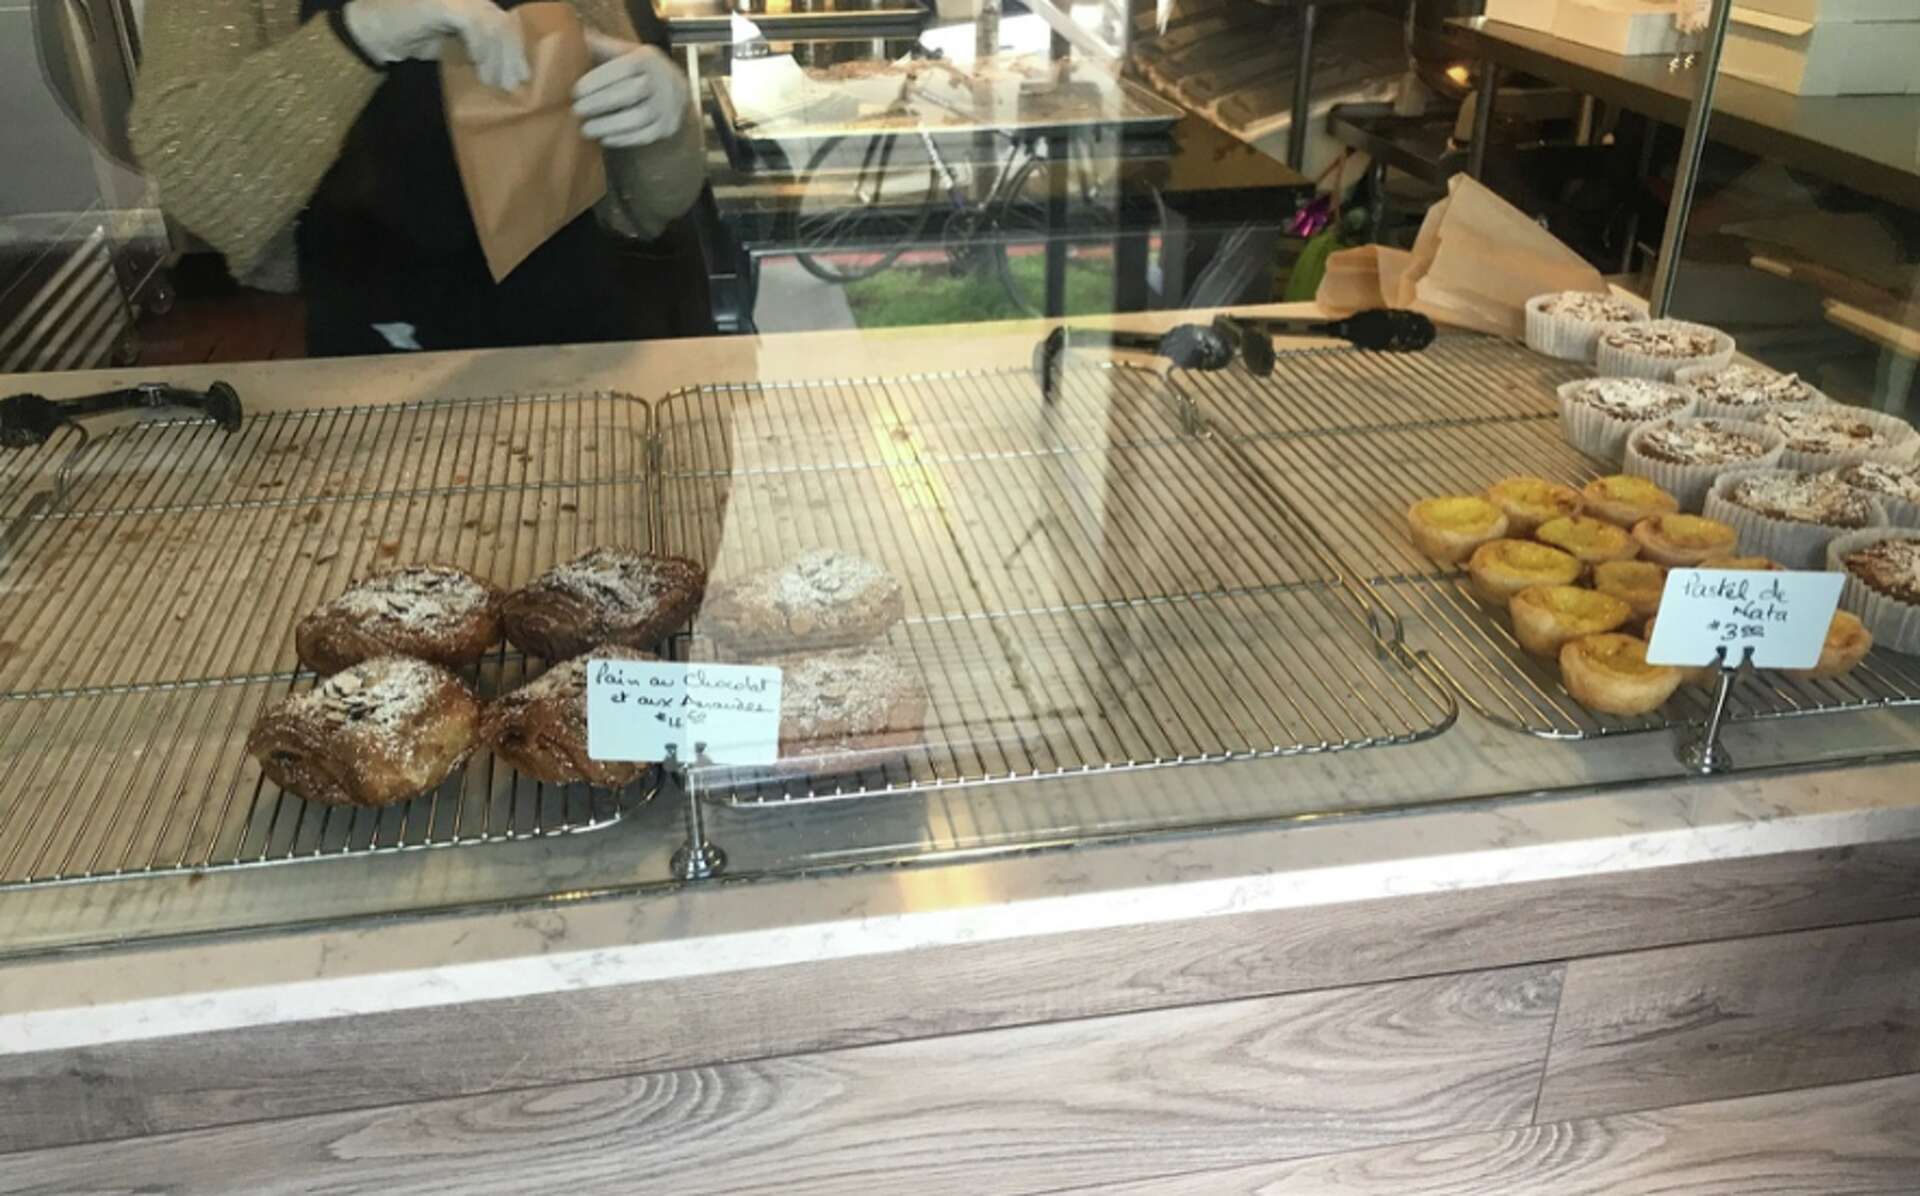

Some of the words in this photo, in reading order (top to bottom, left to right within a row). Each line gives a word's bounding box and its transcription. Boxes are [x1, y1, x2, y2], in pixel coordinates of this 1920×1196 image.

[1759, 577, 1789, 603] de
[1732, 600, 1788, 622] Nata
[596, 661, 640, 686] Pain
[649, 676, 674, 687] au
[683, 669, 777, 692] Chocolat
[610, 690, 628, 703] et
[637, 696, 673, 707] aux
